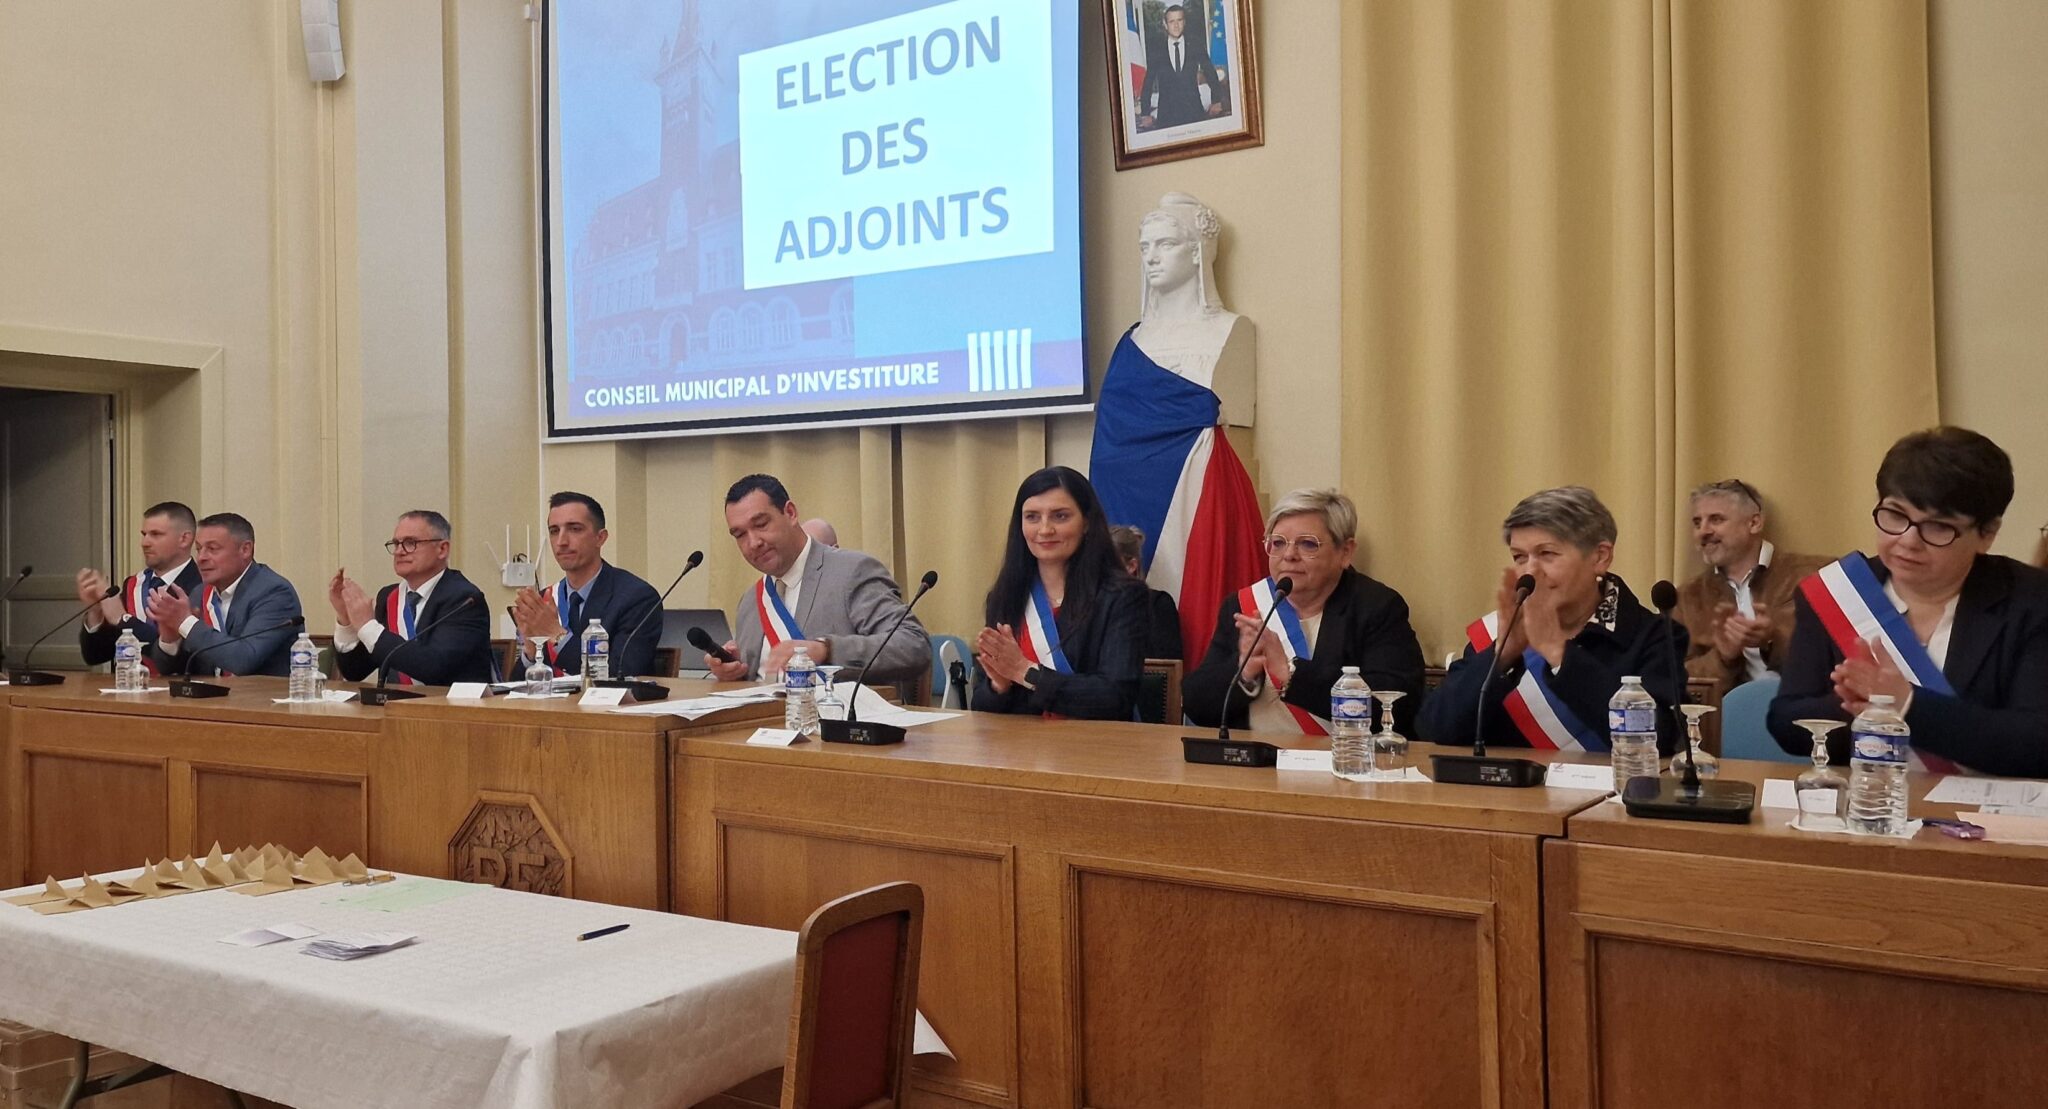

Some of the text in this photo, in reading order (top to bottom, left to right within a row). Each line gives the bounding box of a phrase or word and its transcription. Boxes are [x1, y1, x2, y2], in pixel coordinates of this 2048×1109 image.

[776, 15, 1001, 110] ELECTION
[842, 117, 928, 176] DES
[774, 186, 1010, 264] ADJOINTS
[584, 362, 939, 408] CONSEIL MUNICIPAL D'INVESTITURE
